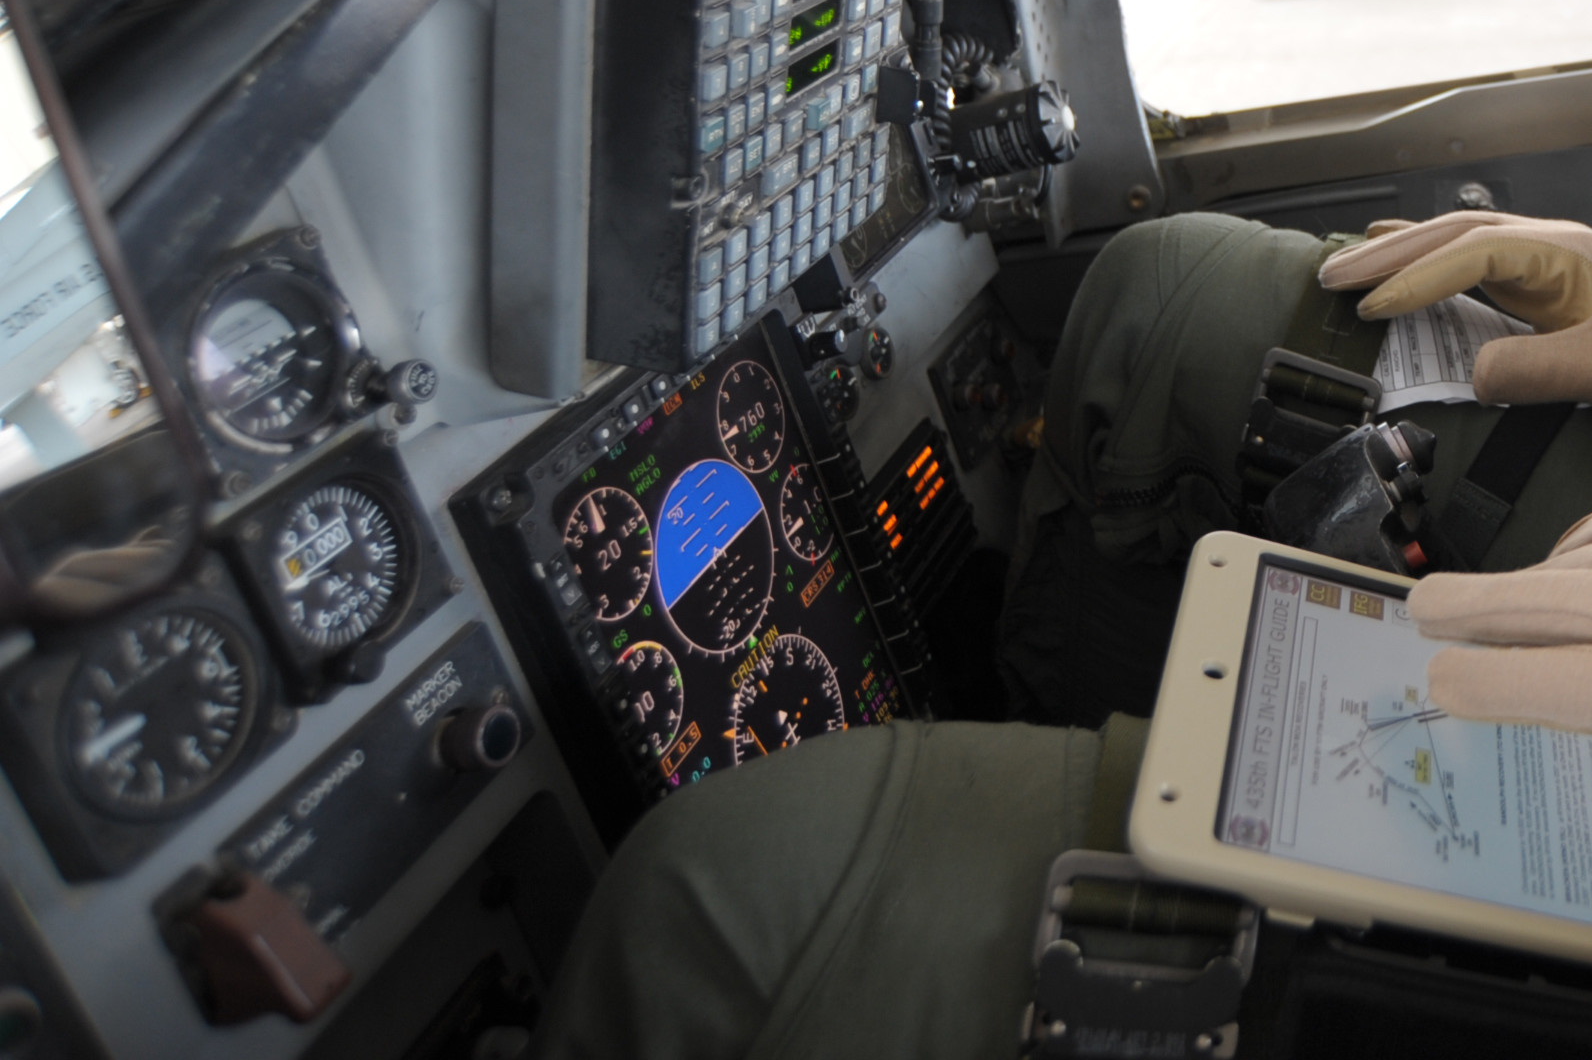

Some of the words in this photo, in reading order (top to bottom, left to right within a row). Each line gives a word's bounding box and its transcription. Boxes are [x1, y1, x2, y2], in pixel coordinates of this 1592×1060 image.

[739, 401, 766, 433] 760
[359, 517, 374, 537] 2
[622, 519, 639, 538] 1.5
[598, 539, 623, 571] 20
[1310, 584, 1326, 602] CC
[1353, 593, 1369, 616] IFG
[1269, 597, 1291, 643] GUIDE
[613, 628, 629, 649] GS
[629, 650, 646, 673] 1.0
[731, 624, 780, 689] CAUTION
[405, 660, 456, 712] MARKER
[1258, 644, 1284, 722] IN-FLIGHT
[413, 675, 463, 726] BEACON
[1252, 725, 1274, 757] FTS
[297, 748, 366, 817] COMMAND
[1246, 757, 1269, 810] 435th
